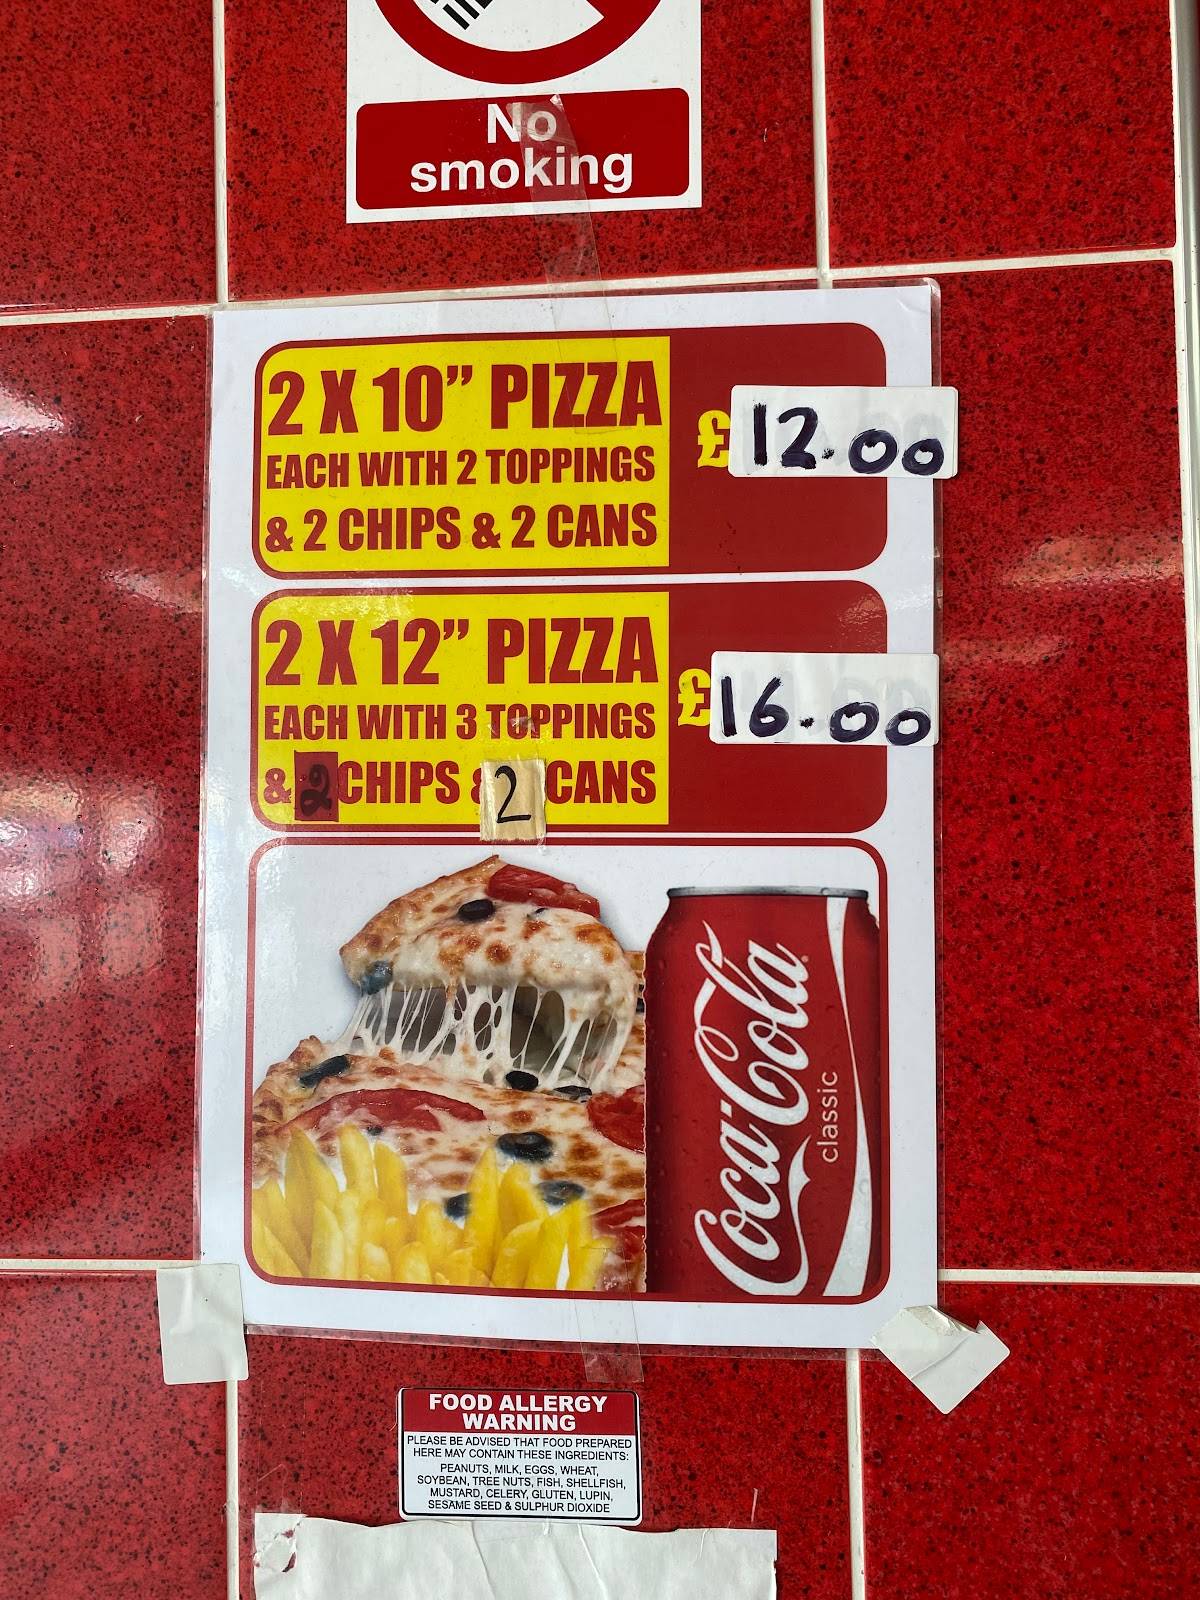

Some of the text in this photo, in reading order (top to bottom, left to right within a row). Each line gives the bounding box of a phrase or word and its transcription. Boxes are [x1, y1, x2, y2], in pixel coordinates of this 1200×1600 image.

[487, 102, 557, 143] No
[410, 146, 633, 194] smoking
[268, 361, 662, 436] 2 X 10” PIZZA
[266, 445, 655, 489] EACH WITH 2 TOPPINGS
[264, 503, 658, 552] & 2 CHIPS & 2 CANS
[265, 617, 658, 685] 2 X 12” PIZZA
[264, 702, 656, 740] EACH WITH 3 TOPPINGS
[263, 768, 291, 804] &
[338, 761, 460, 804] CHIPS
[495, 765, 531, 824] 2
[546, 760, 656, 804] CANS
[694, 920, 811, 1296] Coca-Cola
[817, 1071, 838, 1163] classic
[429, 1394, 607, 1412] FOOD ALLERGY
[463, 1414, 576, 1431] WARNING
[407, 1436, 632, 1448] PLEASE BE ADVISED THAT FOOD PREPARED
[414, 1448, 629, 1461] HERE MAY CONTAIN THESE INGREDIENTS:
[417, 1476, 626, 1489] SOYBEAN, TREE NUTS, FISH, SHELLFISH,
[440, 1464, 599, 1476] PEANUTS, MILK, EGGS, WHEAT,
[428, 1500, 610, 1513] SESAME SEED & SULPHUR DIOXIDE
[430, 1488, 613, 1501] MUSTARD, CELERY, GLUTEN, LUPIN,
